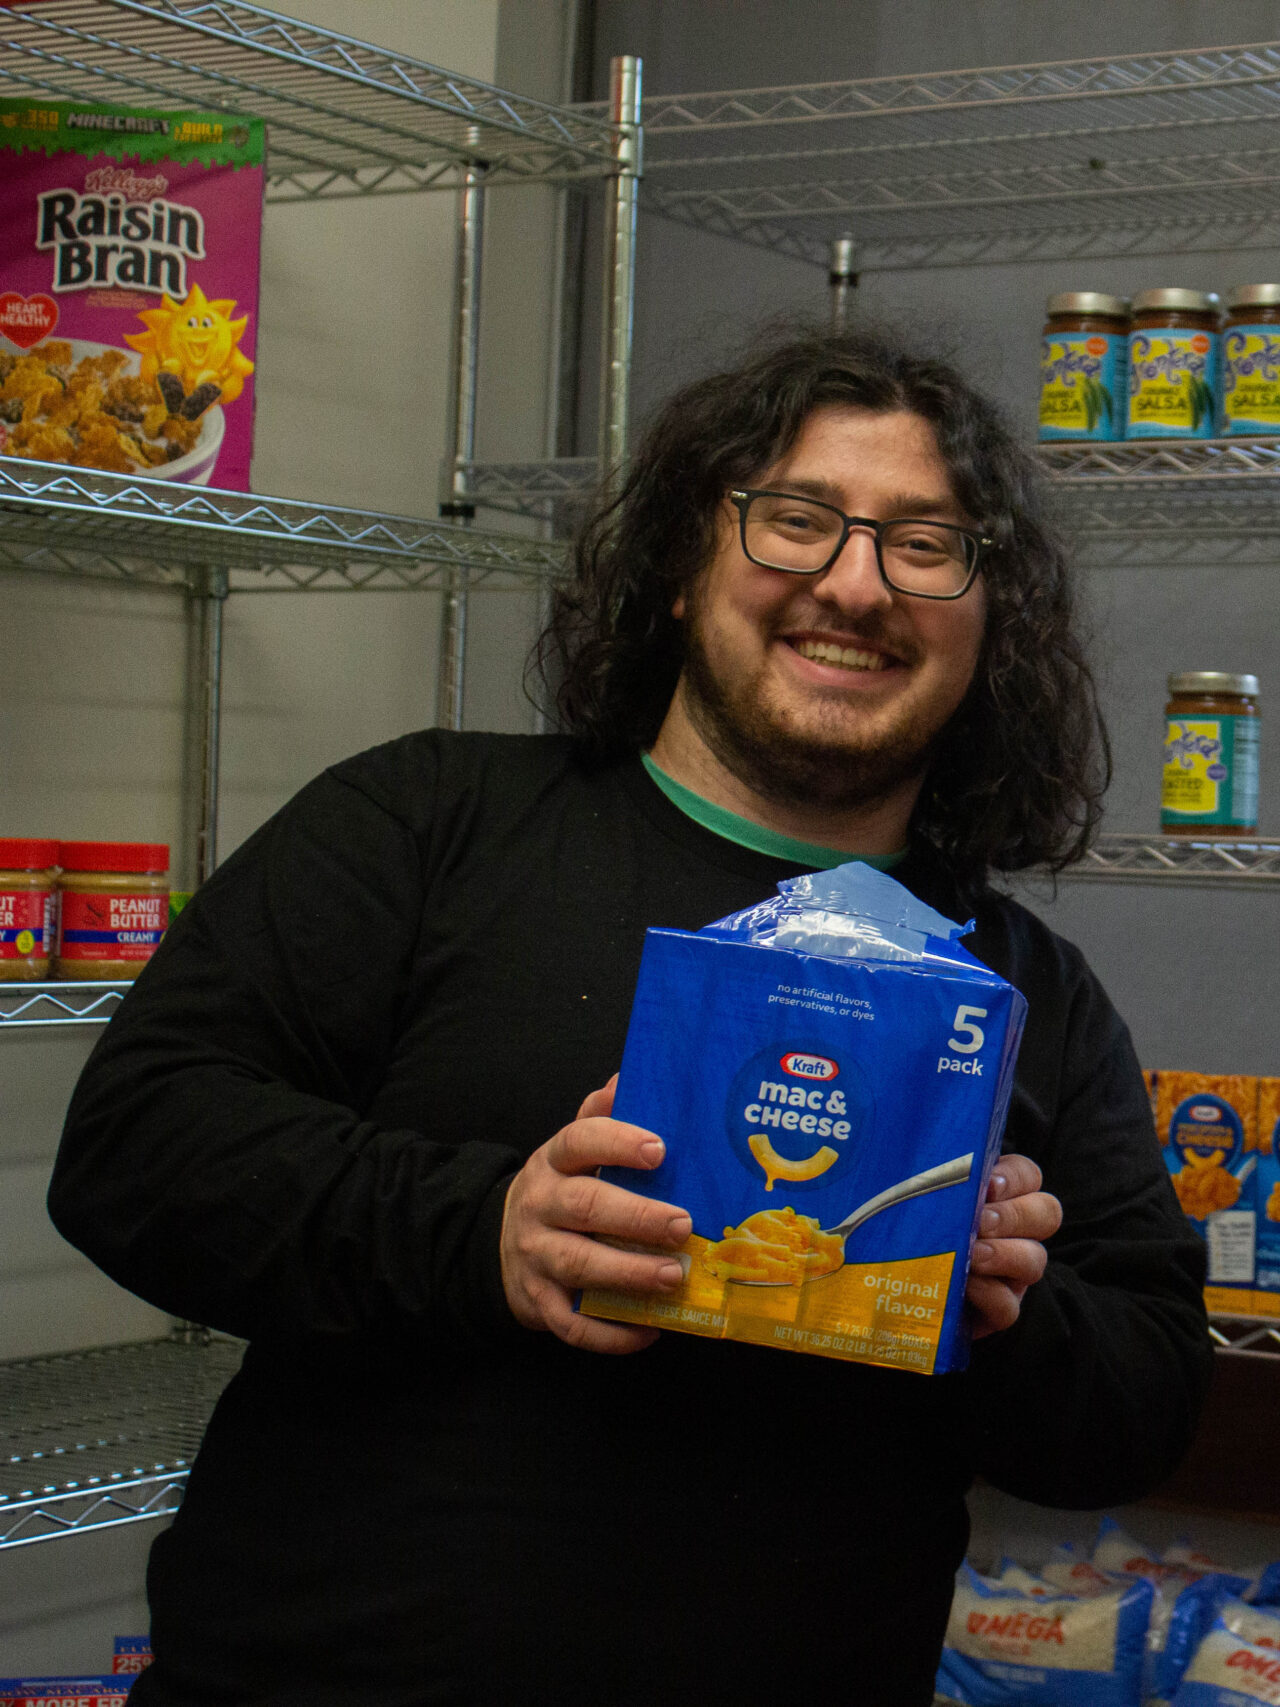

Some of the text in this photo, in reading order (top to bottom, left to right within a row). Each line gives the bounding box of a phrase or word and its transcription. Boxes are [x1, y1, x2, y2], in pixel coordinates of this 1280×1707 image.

[67, 112, 171, 134] MINECRAFT
[85, 165, 168, 198] Kellogg's
[38, 190, 203, 257] Raisin
[54, 240, 186, 297] Bran
[0, 313, 51, 327] HEALTHY
[7, 303, 44, 313] HEART
[110, 899, 161, 913] PEANUT
[110, 914, 160, 928] BUTTER
[117, 932, 154, 943] CREAMY
[767, 994, 875, 1021] preservatives, or dyes
[777, 984, 872, 1010] no artificial flavors,
[947, 1004, 988, 1054] 5
[792, 1058, 827, 1077] Kraft
[937, 1054, 984, 1077] pack
[758, 1080, 847, 1116] mac &
[863, 1273, 940, 1299] original
[681, 1309, 711, 1325] SAUCE
[711, 1314, 729, 1328] MIX
[875, 1293, 937, 1320] flavor
[773, 1324, 793, 1340] NET
[832, 1336, 846, 1351] OZ
[854, 1341, 867, 1354] LB
[901, 1332, 932, 1350] BOXES
